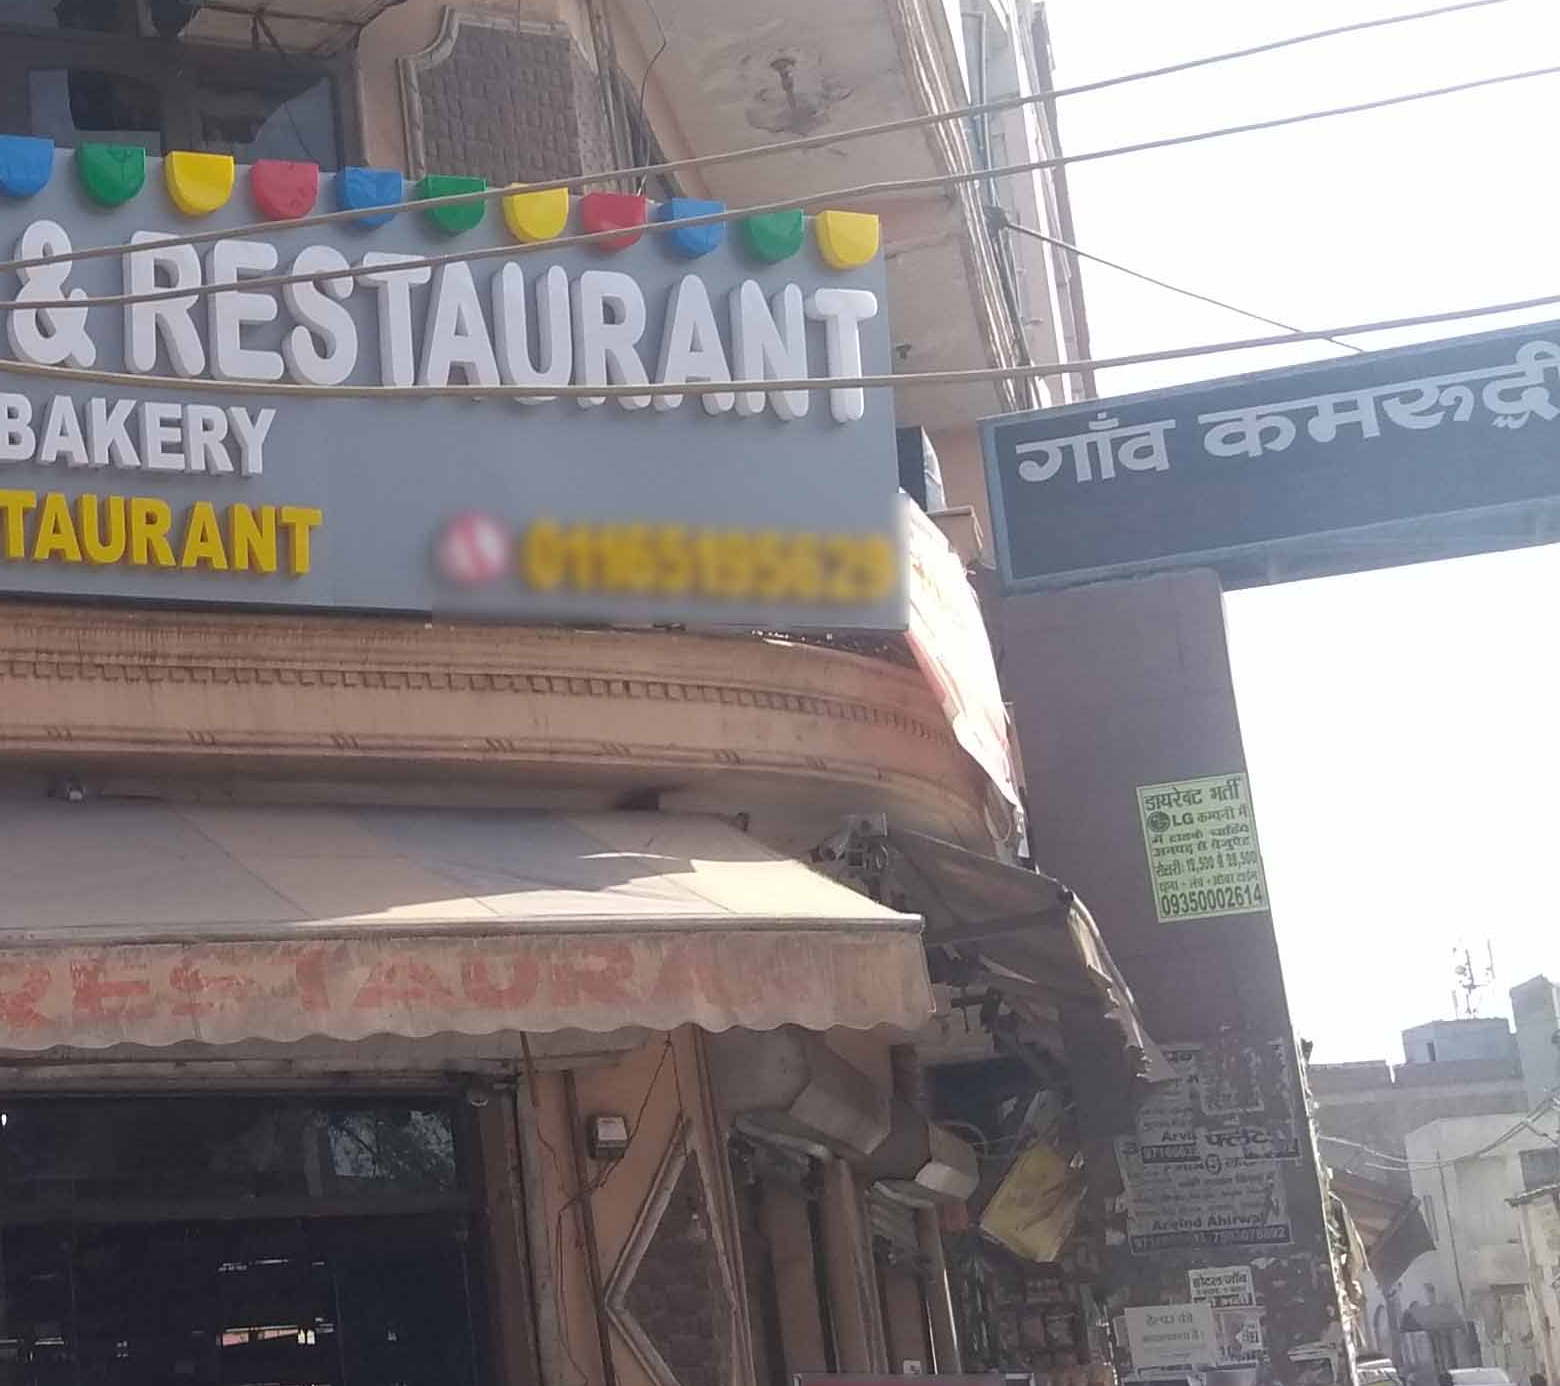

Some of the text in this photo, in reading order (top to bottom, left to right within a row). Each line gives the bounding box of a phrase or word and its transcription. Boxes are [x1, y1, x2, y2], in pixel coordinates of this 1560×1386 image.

[7, 219, 97, 368] &
[122, 229, 878, 424] RESTAURANT
[1172, 813, 1194, 827] LG
[1160, 882, 1264, 916] 09350002614
